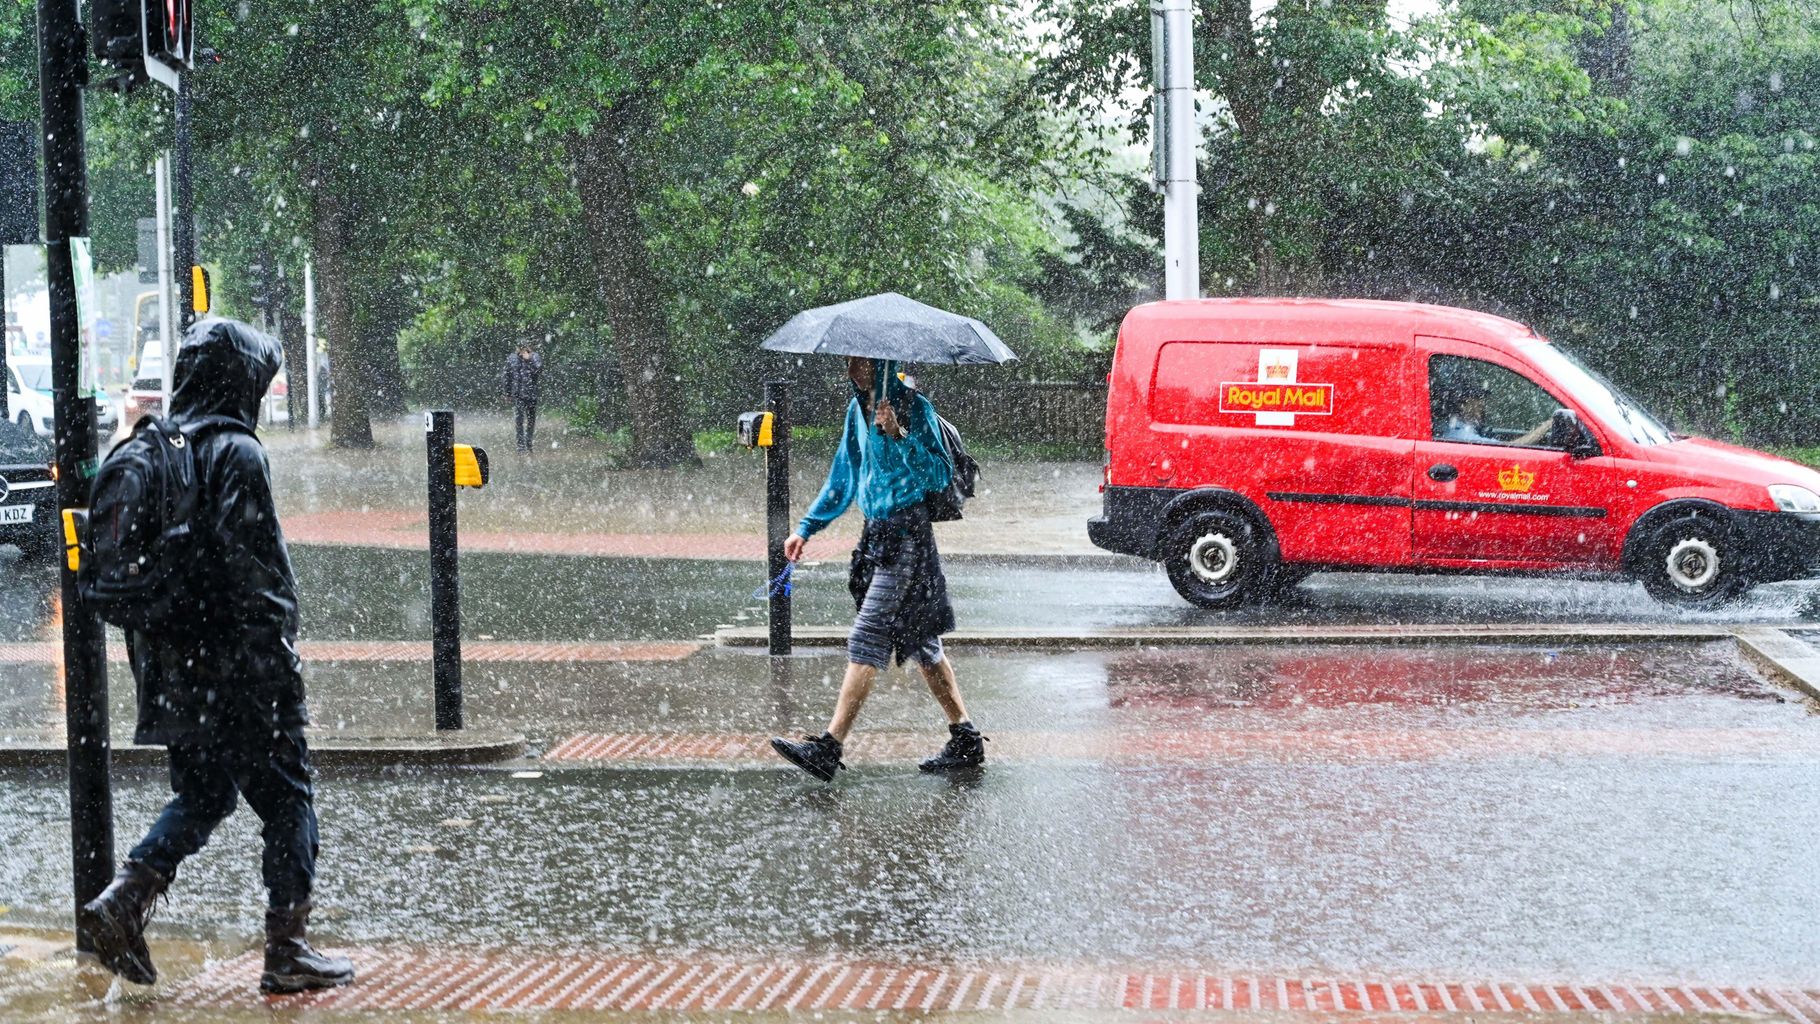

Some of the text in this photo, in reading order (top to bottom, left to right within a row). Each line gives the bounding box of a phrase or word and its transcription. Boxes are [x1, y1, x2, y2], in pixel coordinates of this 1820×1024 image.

[1228, 386, 1325, 408] Royal Mail
[1479, 491, 1549, 501] www.royalmail.com
[4, 508, 27, 520] KDZ
